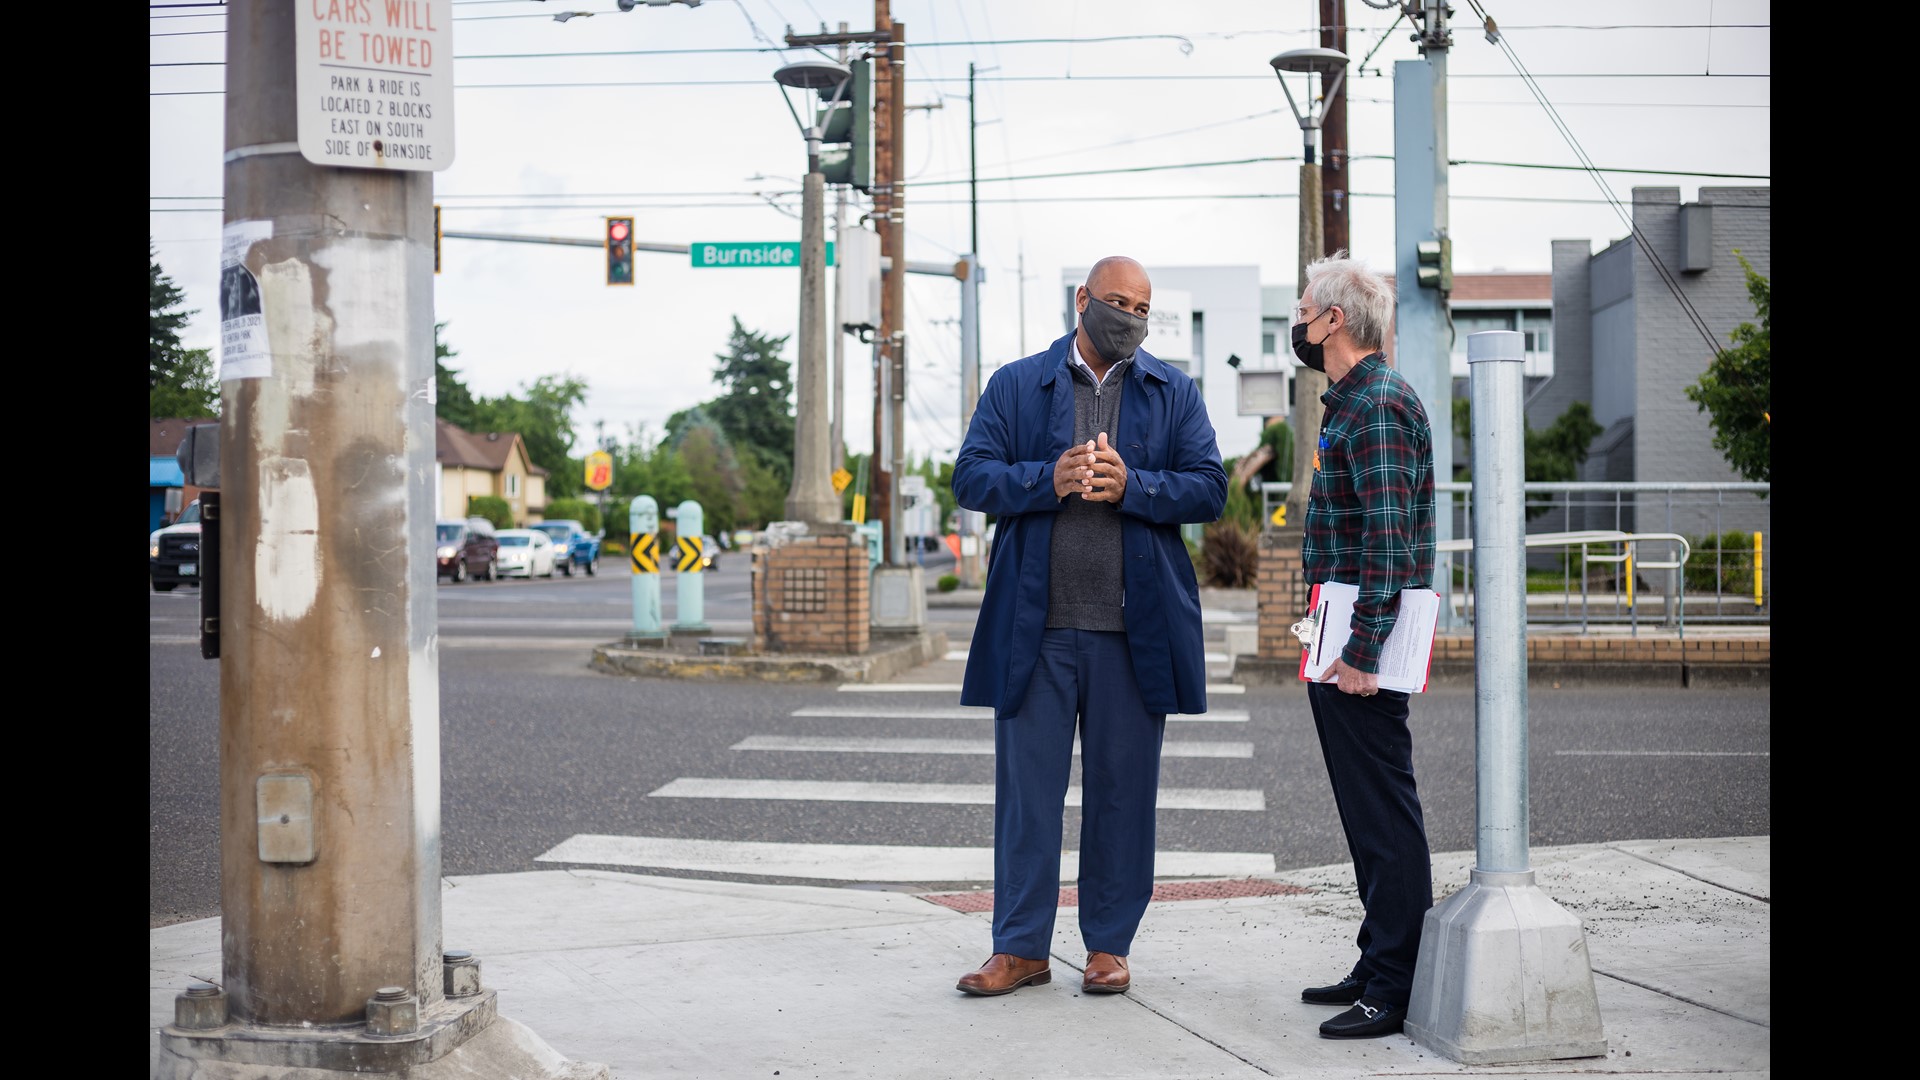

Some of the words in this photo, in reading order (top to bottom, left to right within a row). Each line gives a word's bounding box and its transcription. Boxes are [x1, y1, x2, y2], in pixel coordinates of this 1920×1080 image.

[312, 0, 371, 24] CARS
[386, 0, 437, 32] WILL
[319, 29, 346, 60] BE
[360, 33, 432, 68] TOWED
[331, 75, 360, 92] PARK
[367, 78, 374, 93] &
[379, 80, 404, 96] RIDE
[410, 81, 421, 97] IS
[320, 96, 371, 115] LOCATED
[377, 100, 384, 116] 2
[389, 101, 432, 119] BLOCKS
[331, 118, 359, 135] EAST
[366, 120, 381, 136] ON
[387, 121, 424, 138] SOUTH
[325, 139, 350, 156] SIDE
[357, 141, 370, 157] OF
[703, 245, 794, 265] Burnside
